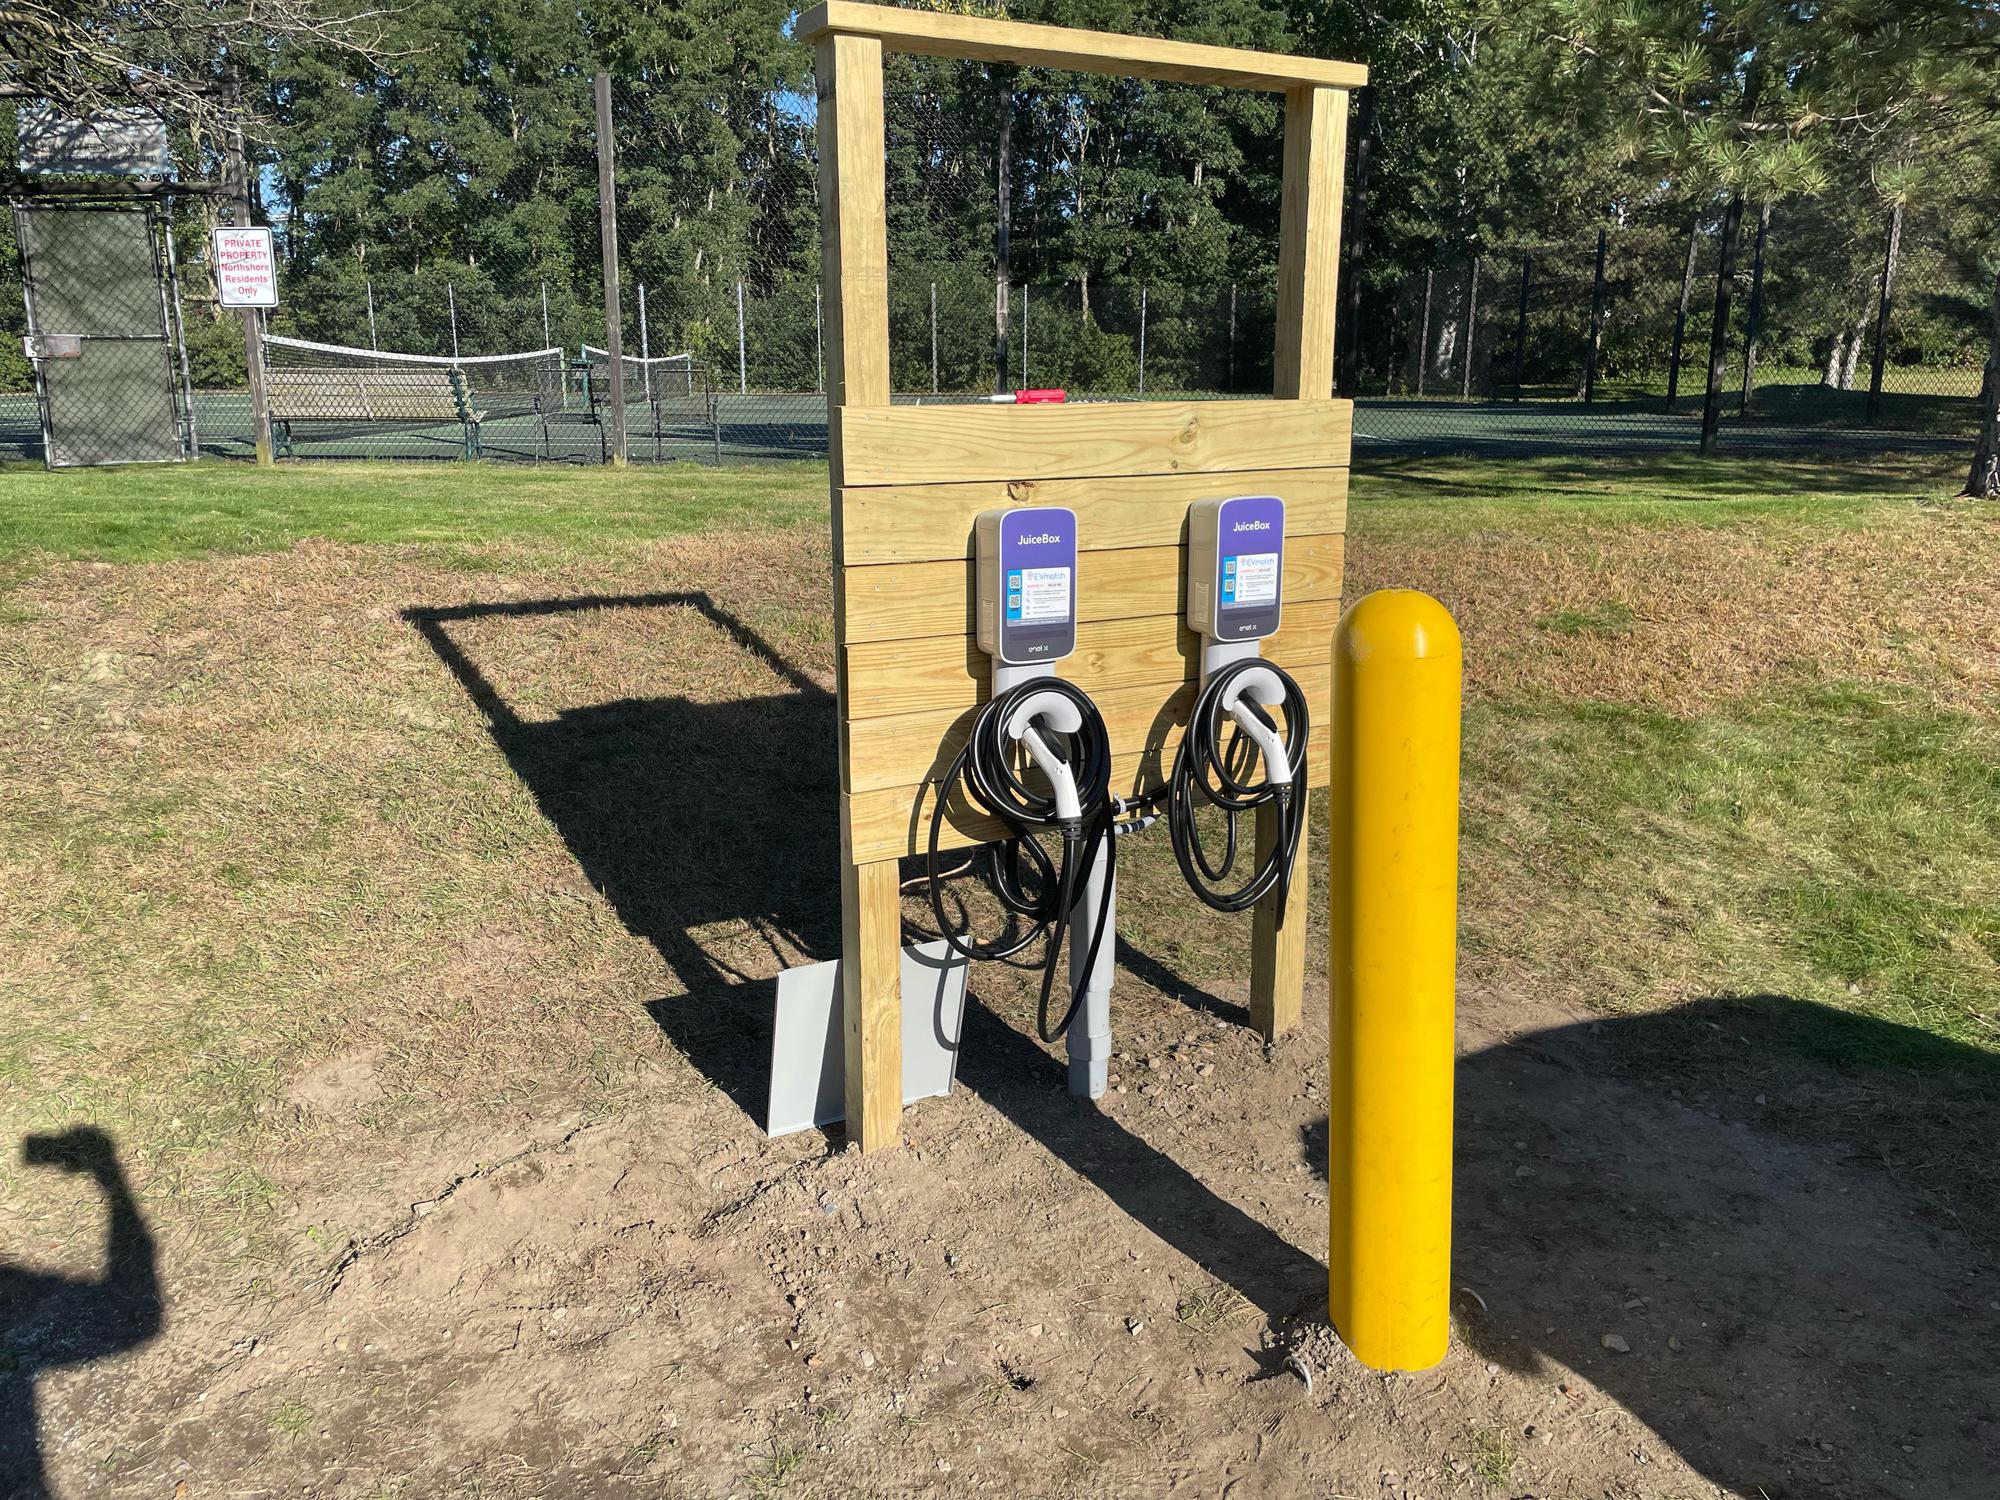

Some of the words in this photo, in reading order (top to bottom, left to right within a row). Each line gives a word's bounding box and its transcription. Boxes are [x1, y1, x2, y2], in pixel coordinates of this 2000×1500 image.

[224, 239, 262, 248] PRIVATE
[220, 251, 268, 260] PROPERTY
[221, 263, 270, 272] Northshore
[225, 274, 269, 283] Residents
[238, 286, 258, 297] Only
[1233, 520, 1270, 532] JuiceBox
[1017, 533, 1061, 546] JuiceBox
